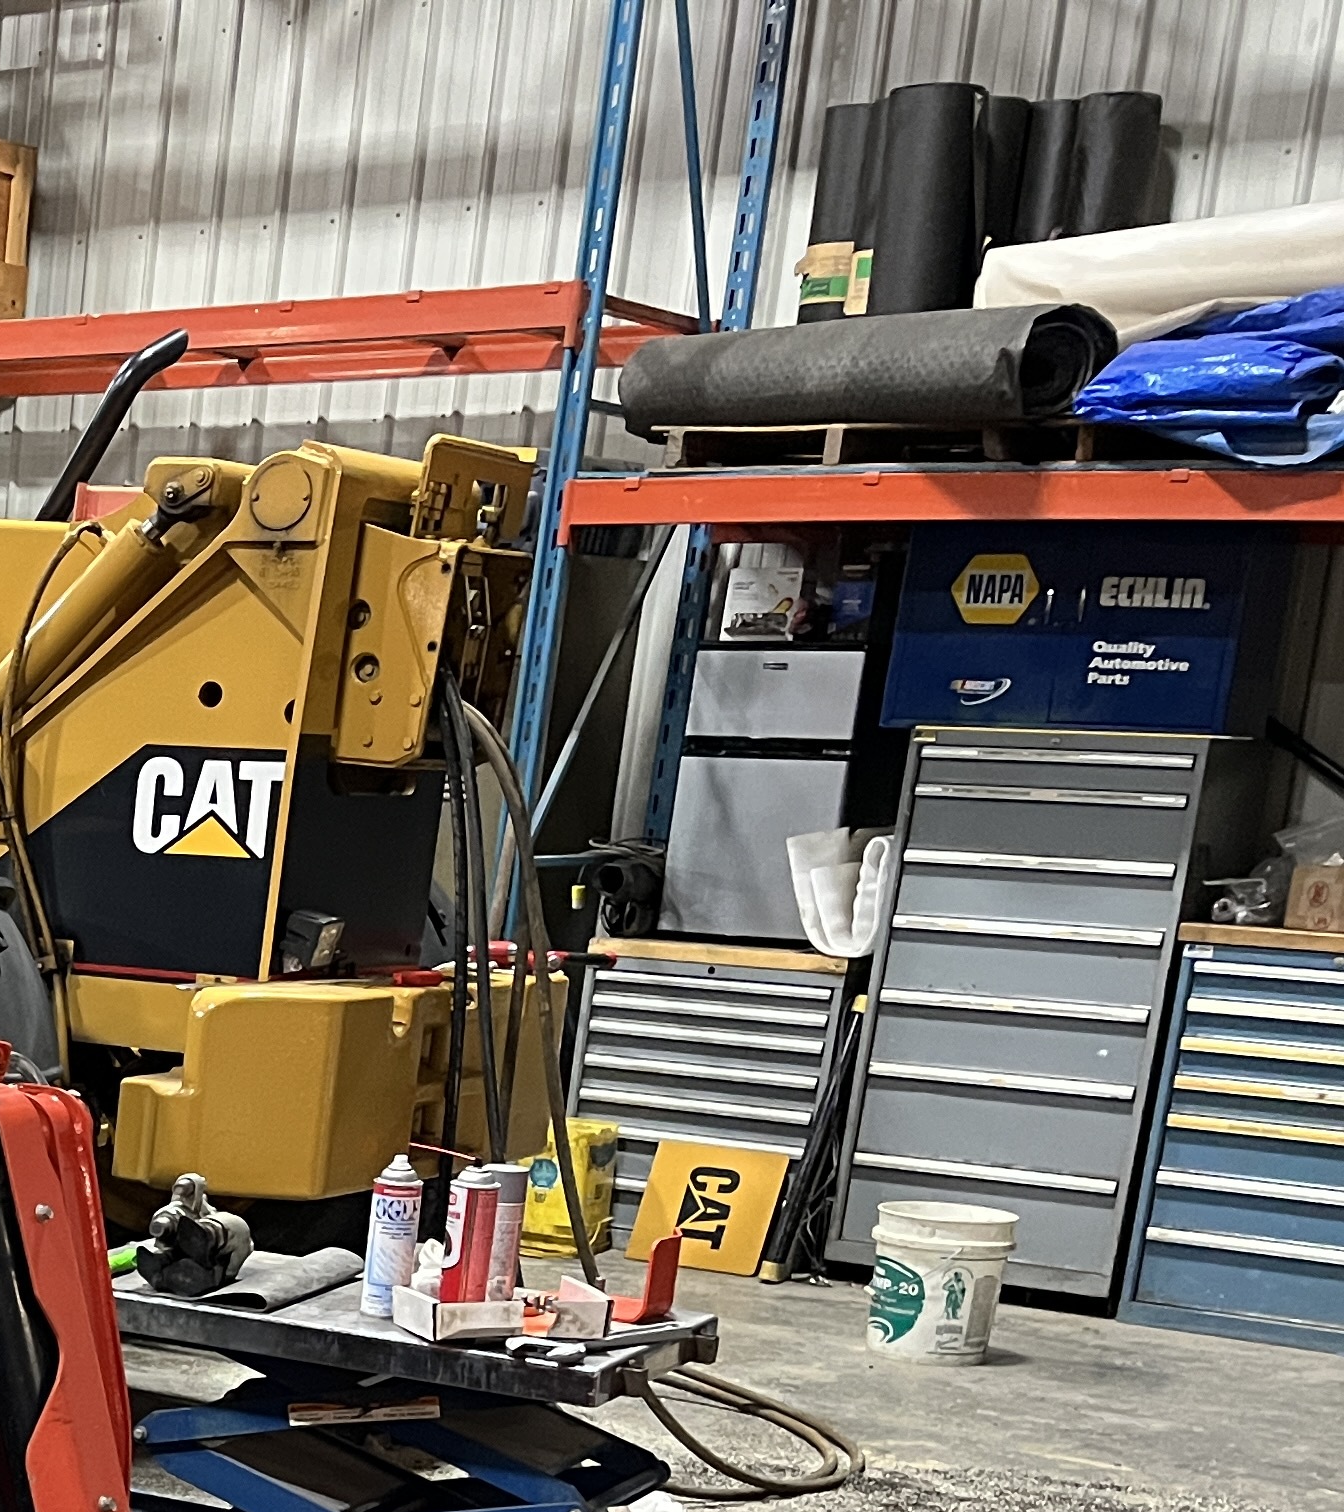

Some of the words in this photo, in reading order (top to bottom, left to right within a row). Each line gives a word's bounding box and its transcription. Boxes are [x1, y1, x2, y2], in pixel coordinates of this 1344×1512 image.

[966, 573, 1024, 605] NAPA
[1092, 640, 1156, 658] Quality
[1087, 656, 1190, 672] Automotive
[1087, 671, 1130, 686] Parts
[132, 756, 286, 859] CAT
[679, 1166, 741, 1251] CAT
